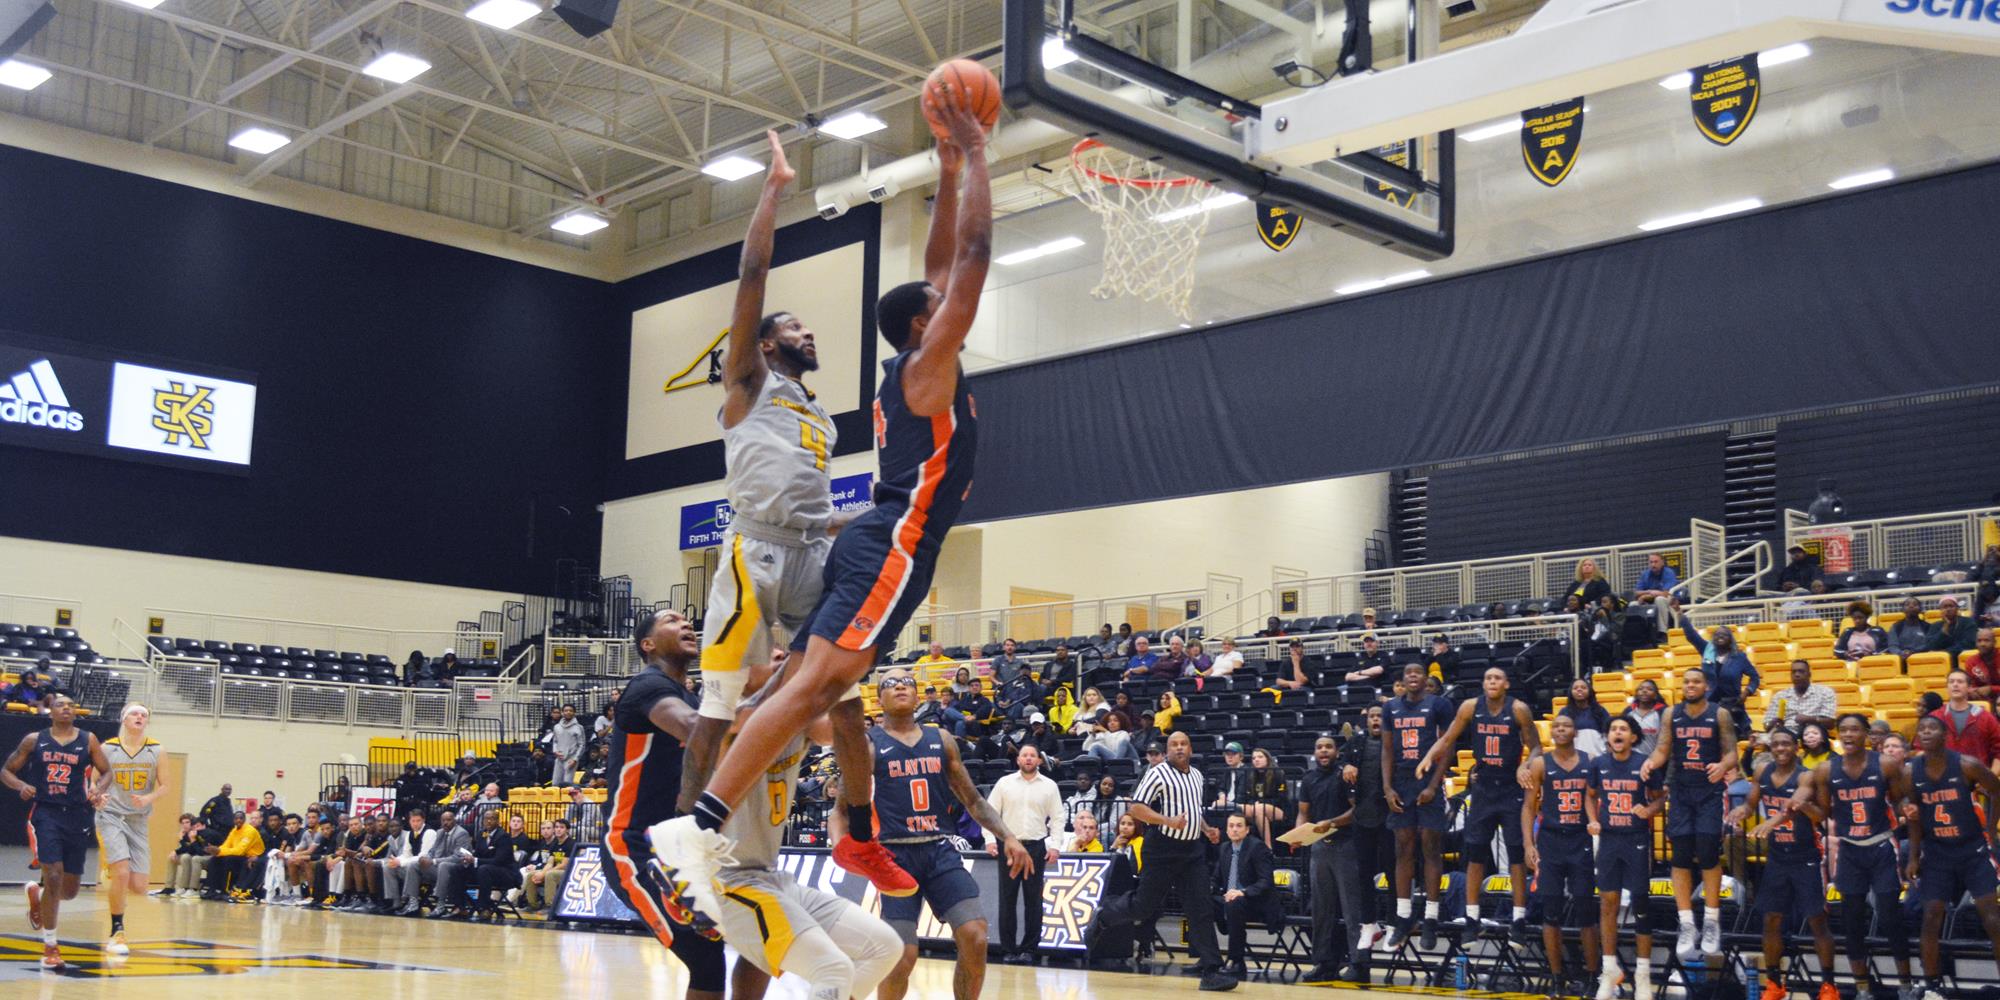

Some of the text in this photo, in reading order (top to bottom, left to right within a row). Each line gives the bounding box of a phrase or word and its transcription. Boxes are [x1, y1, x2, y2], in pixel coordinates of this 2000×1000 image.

[1701, 72, 1746, 90] CHAMPIONS
[1703, 65, 1742, 82] NATIONAL
[1691, 90, 1715, 101] NCAA
[1715, 80, 1747, 96] DIVISION
[1555, 106, 1580, 121] SEASON
[1710, 96, 1742, 113] 2004
[1532, 119, 1573, 134] CHAMPIONS
[1540, 134, 1566, 148] 2016
[0, 397, 84, 432] didas
[798, 418, 826, 474] 4
[847, 488, 856, 499] of
[842, 500, 873, 513] Athletics
[689, 533, 710, 545] FIFTH
[1394, 717, 1426, 728] CLAYTON
[1477, 723, 1510, 735] CLAYTON
[1401, 729, 1419, 748] 15
[1676, 727, 1713, 739] CLAYTON
[1485, 735, 1500, 756] 11
[1686, 739, 1701, 760] 2
[43, 751, 80, 765] CLAYTON
[47, 763, 72, 784] 22
[887, 757, 942, 778] CLAYTON
[115, 770, 148, 792] 45
[1602, 779, 1639, 791] CLAYTON
[910, 778, 930, 812] 0
[1558, 791, 1582, 812] 33
[1837, 786, 1877, 801] CLAYTON
[1922, 788, 1959, 805] CLAYTON
[1607, 792, 1633, 814] 20
[1851, 802, 1867, 824] 5
[1934, 804, 1952, 825] 4
[906, 815, 940, 833] STATE
